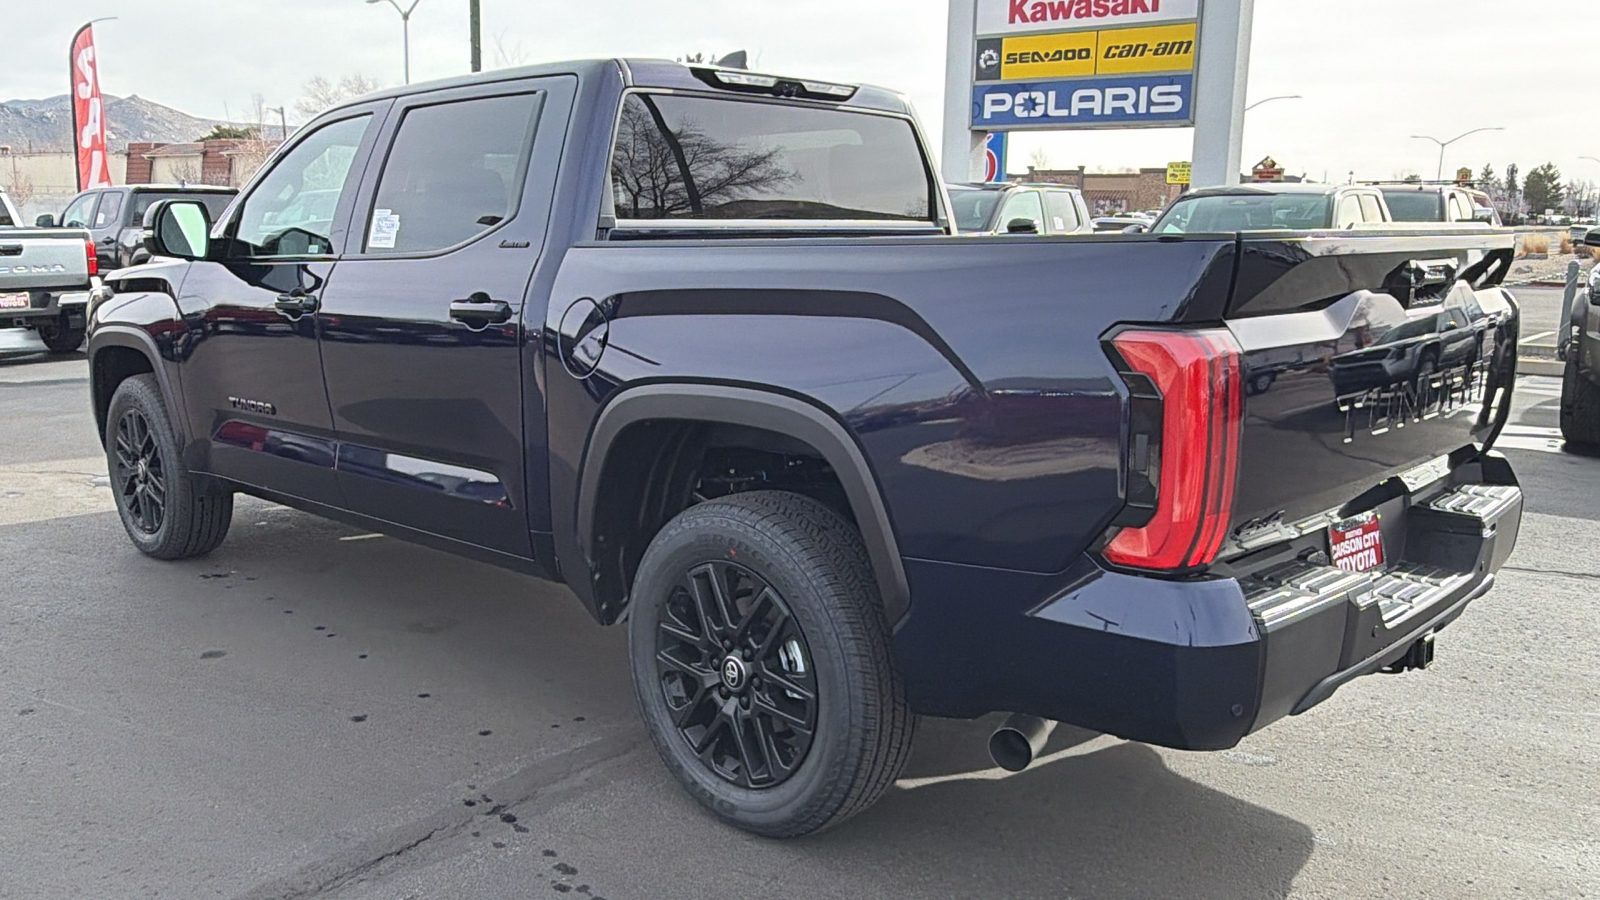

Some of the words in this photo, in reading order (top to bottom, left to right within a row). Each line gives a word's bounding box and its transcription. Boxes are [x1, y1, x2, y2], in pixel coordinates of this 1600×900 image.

[983, 85, 1183, 119] POLARIS
[228, 396, 276, 415] TUNDRA
[1332, 536, 1363, 559] CARSON
[1363, 530, 1380, 548] CITY
[1336, 547, 1377, 573] TOYOTA
